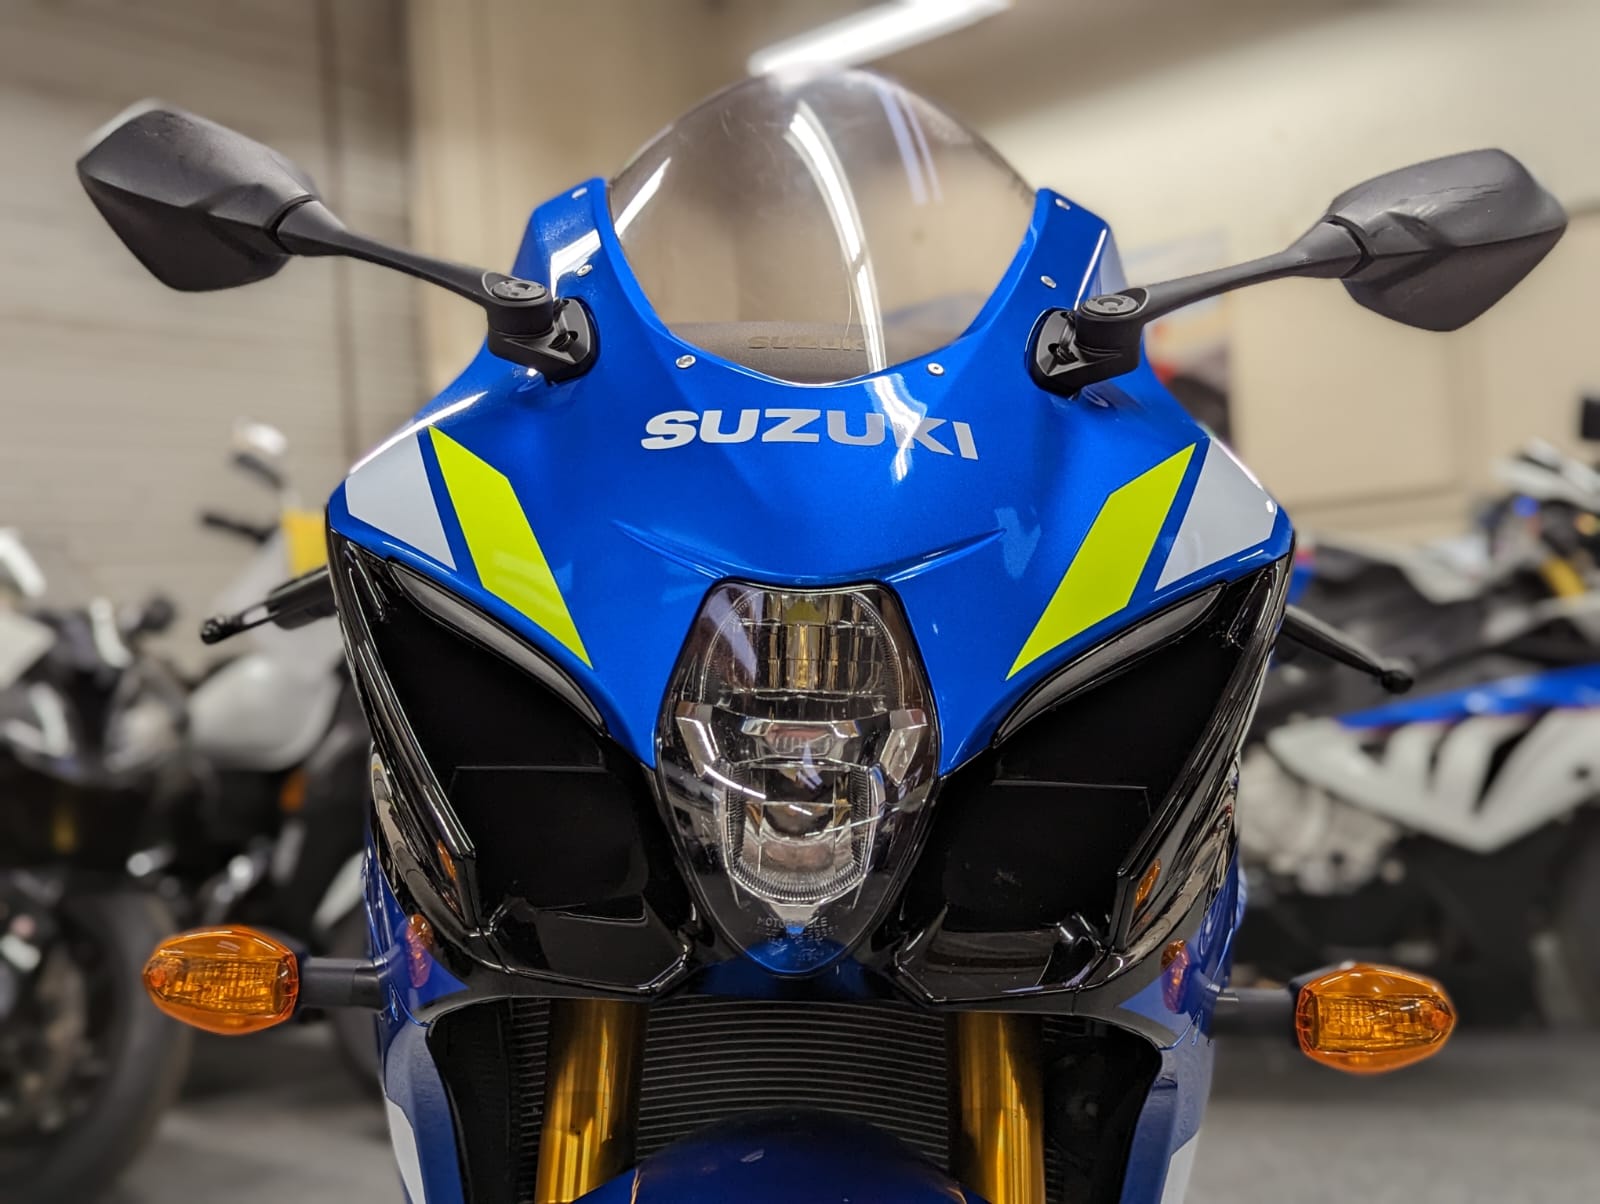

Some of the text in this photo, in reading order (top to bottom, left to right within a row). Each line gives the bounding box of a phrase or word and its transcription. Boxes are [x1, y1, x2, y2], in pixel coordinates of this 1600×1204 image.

[748, 335, 867, 352] SUZUK
[640, 408, 979, 461] SUZUKI
[756, 915, 829, 929] MOTORLE
